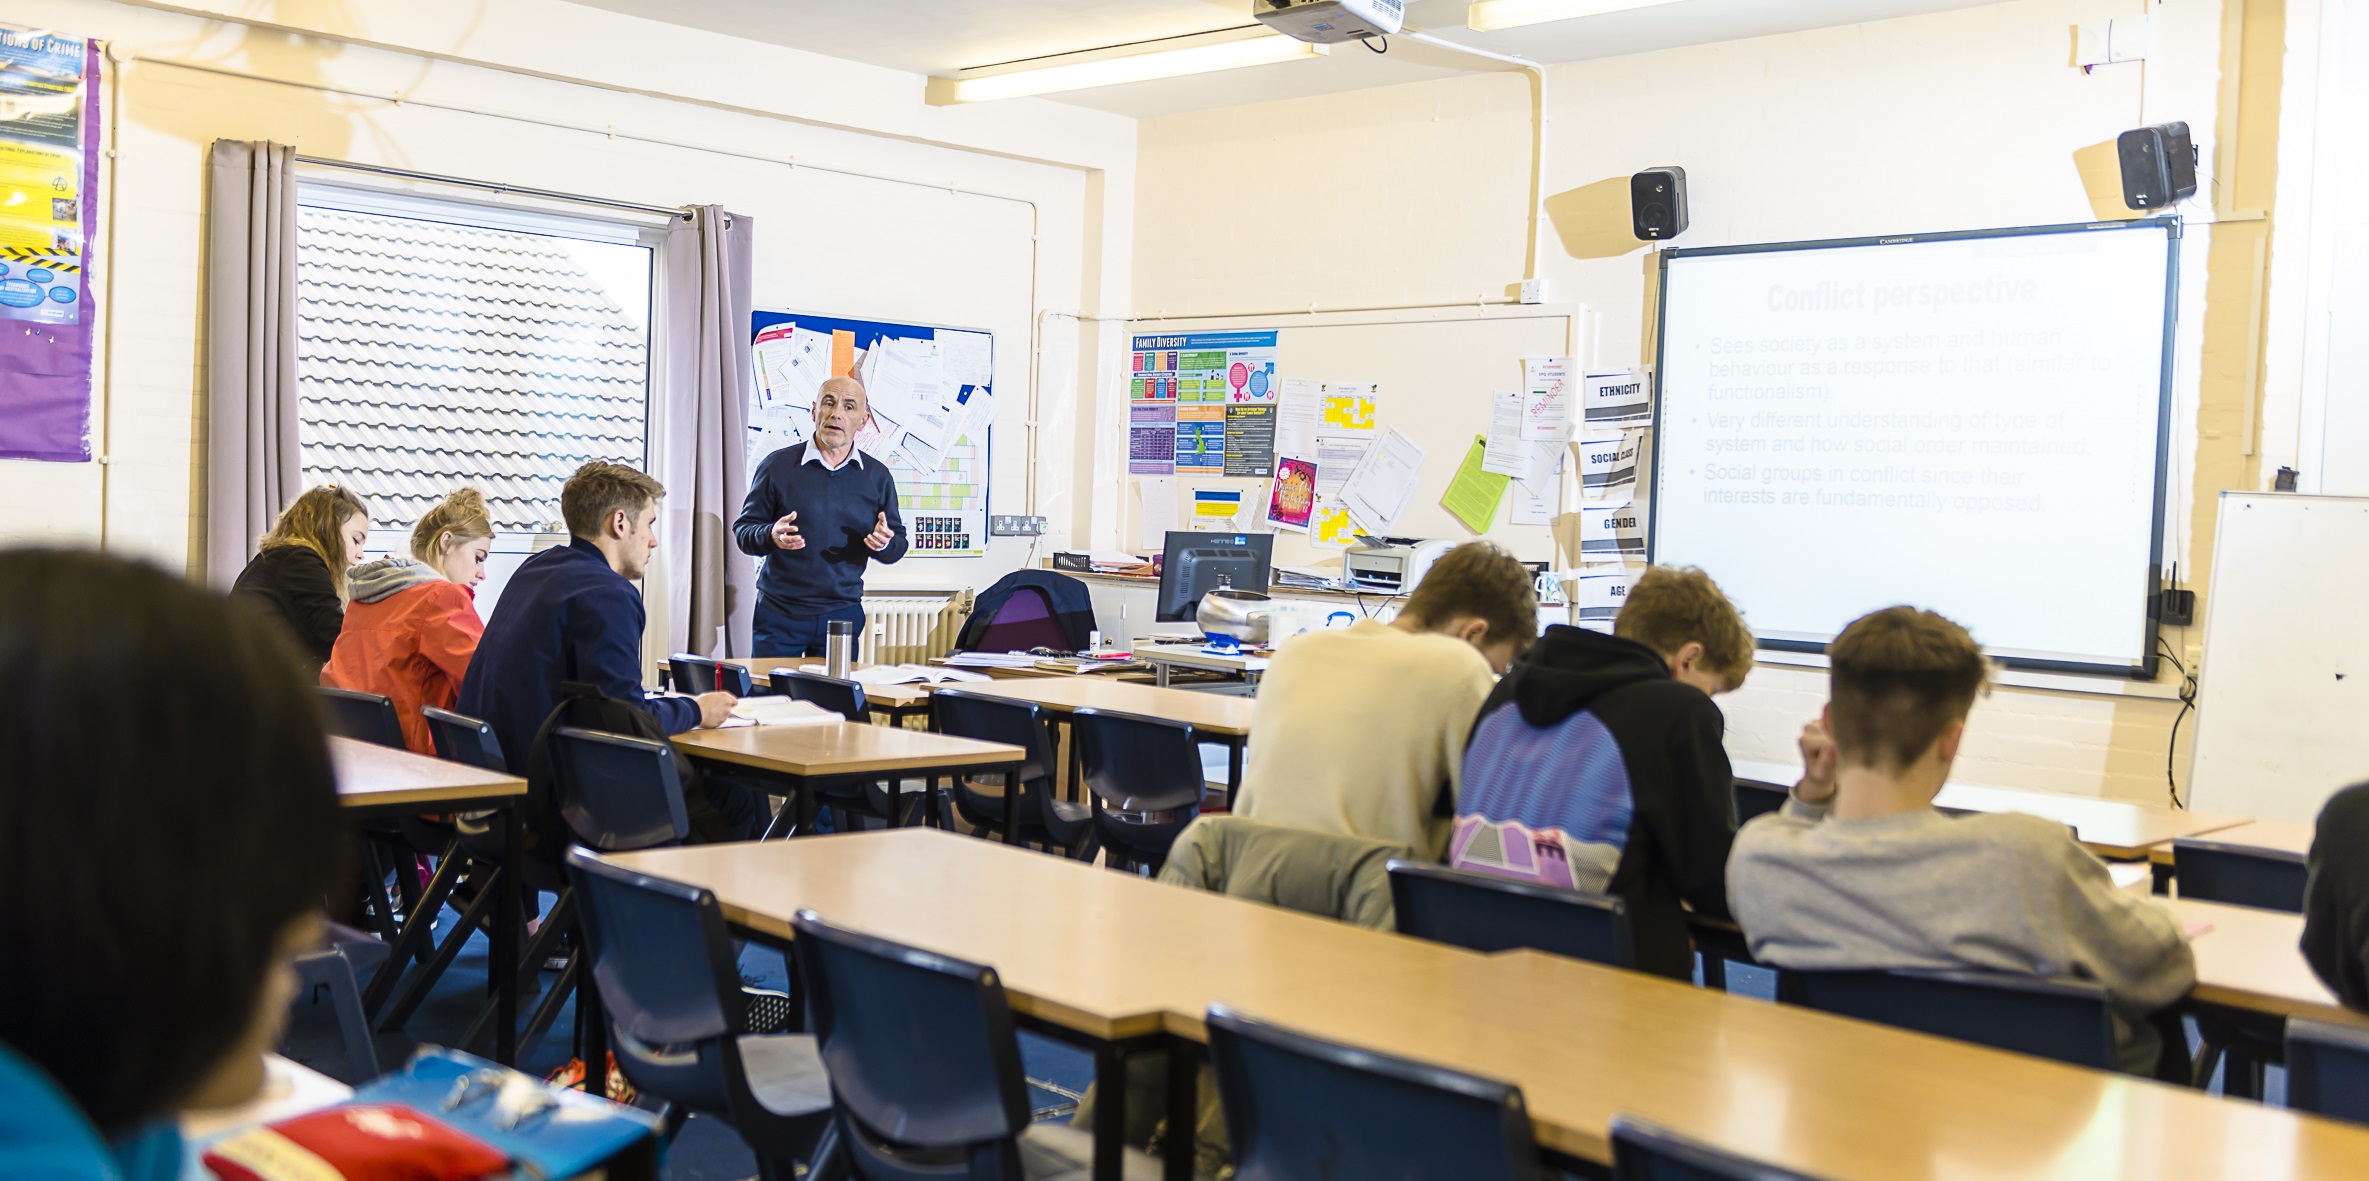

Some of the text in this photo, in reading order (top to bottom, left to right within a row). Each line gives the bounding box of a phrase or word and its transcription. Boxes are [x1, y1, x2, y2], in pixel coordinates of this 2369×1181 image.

[31, 38, 45, 51] OF
[47, 39, 81, 58] CRIME
[1880, 237, 1914, 245] CAMBRIDGE
[1767, 273, 2037, 316] Conflict perspective
[1135, 337, 1156, 349] FAMILY
[1157, 336, 1187, 348] DIVERSITY
[1710, 329, 2062, 355] Sees society as a system and human
[1710, 353, 2111, 378] behaviour as a response to that (similar to
[1530, 380, 1566, 418] REMINDER
[1600, 382, 1641, 398] ETHNICITY
[1708, 383, 1833, 403] functionalism).
[1707, 410, 2067, 432] Very different understanding of type of
[1706, 435, 2092, 456] system and how social order maintained.
[1591, 452, 1619, 464] SOCIAL
[1705, 463, 2025, 486] Social groups in conflict since their
[1703, 486, 2047, 514] interests are fundamentally opposed.
[1604, 517, 1637, 529] GENDER
[1610, 586, 1626, 597] AGE
